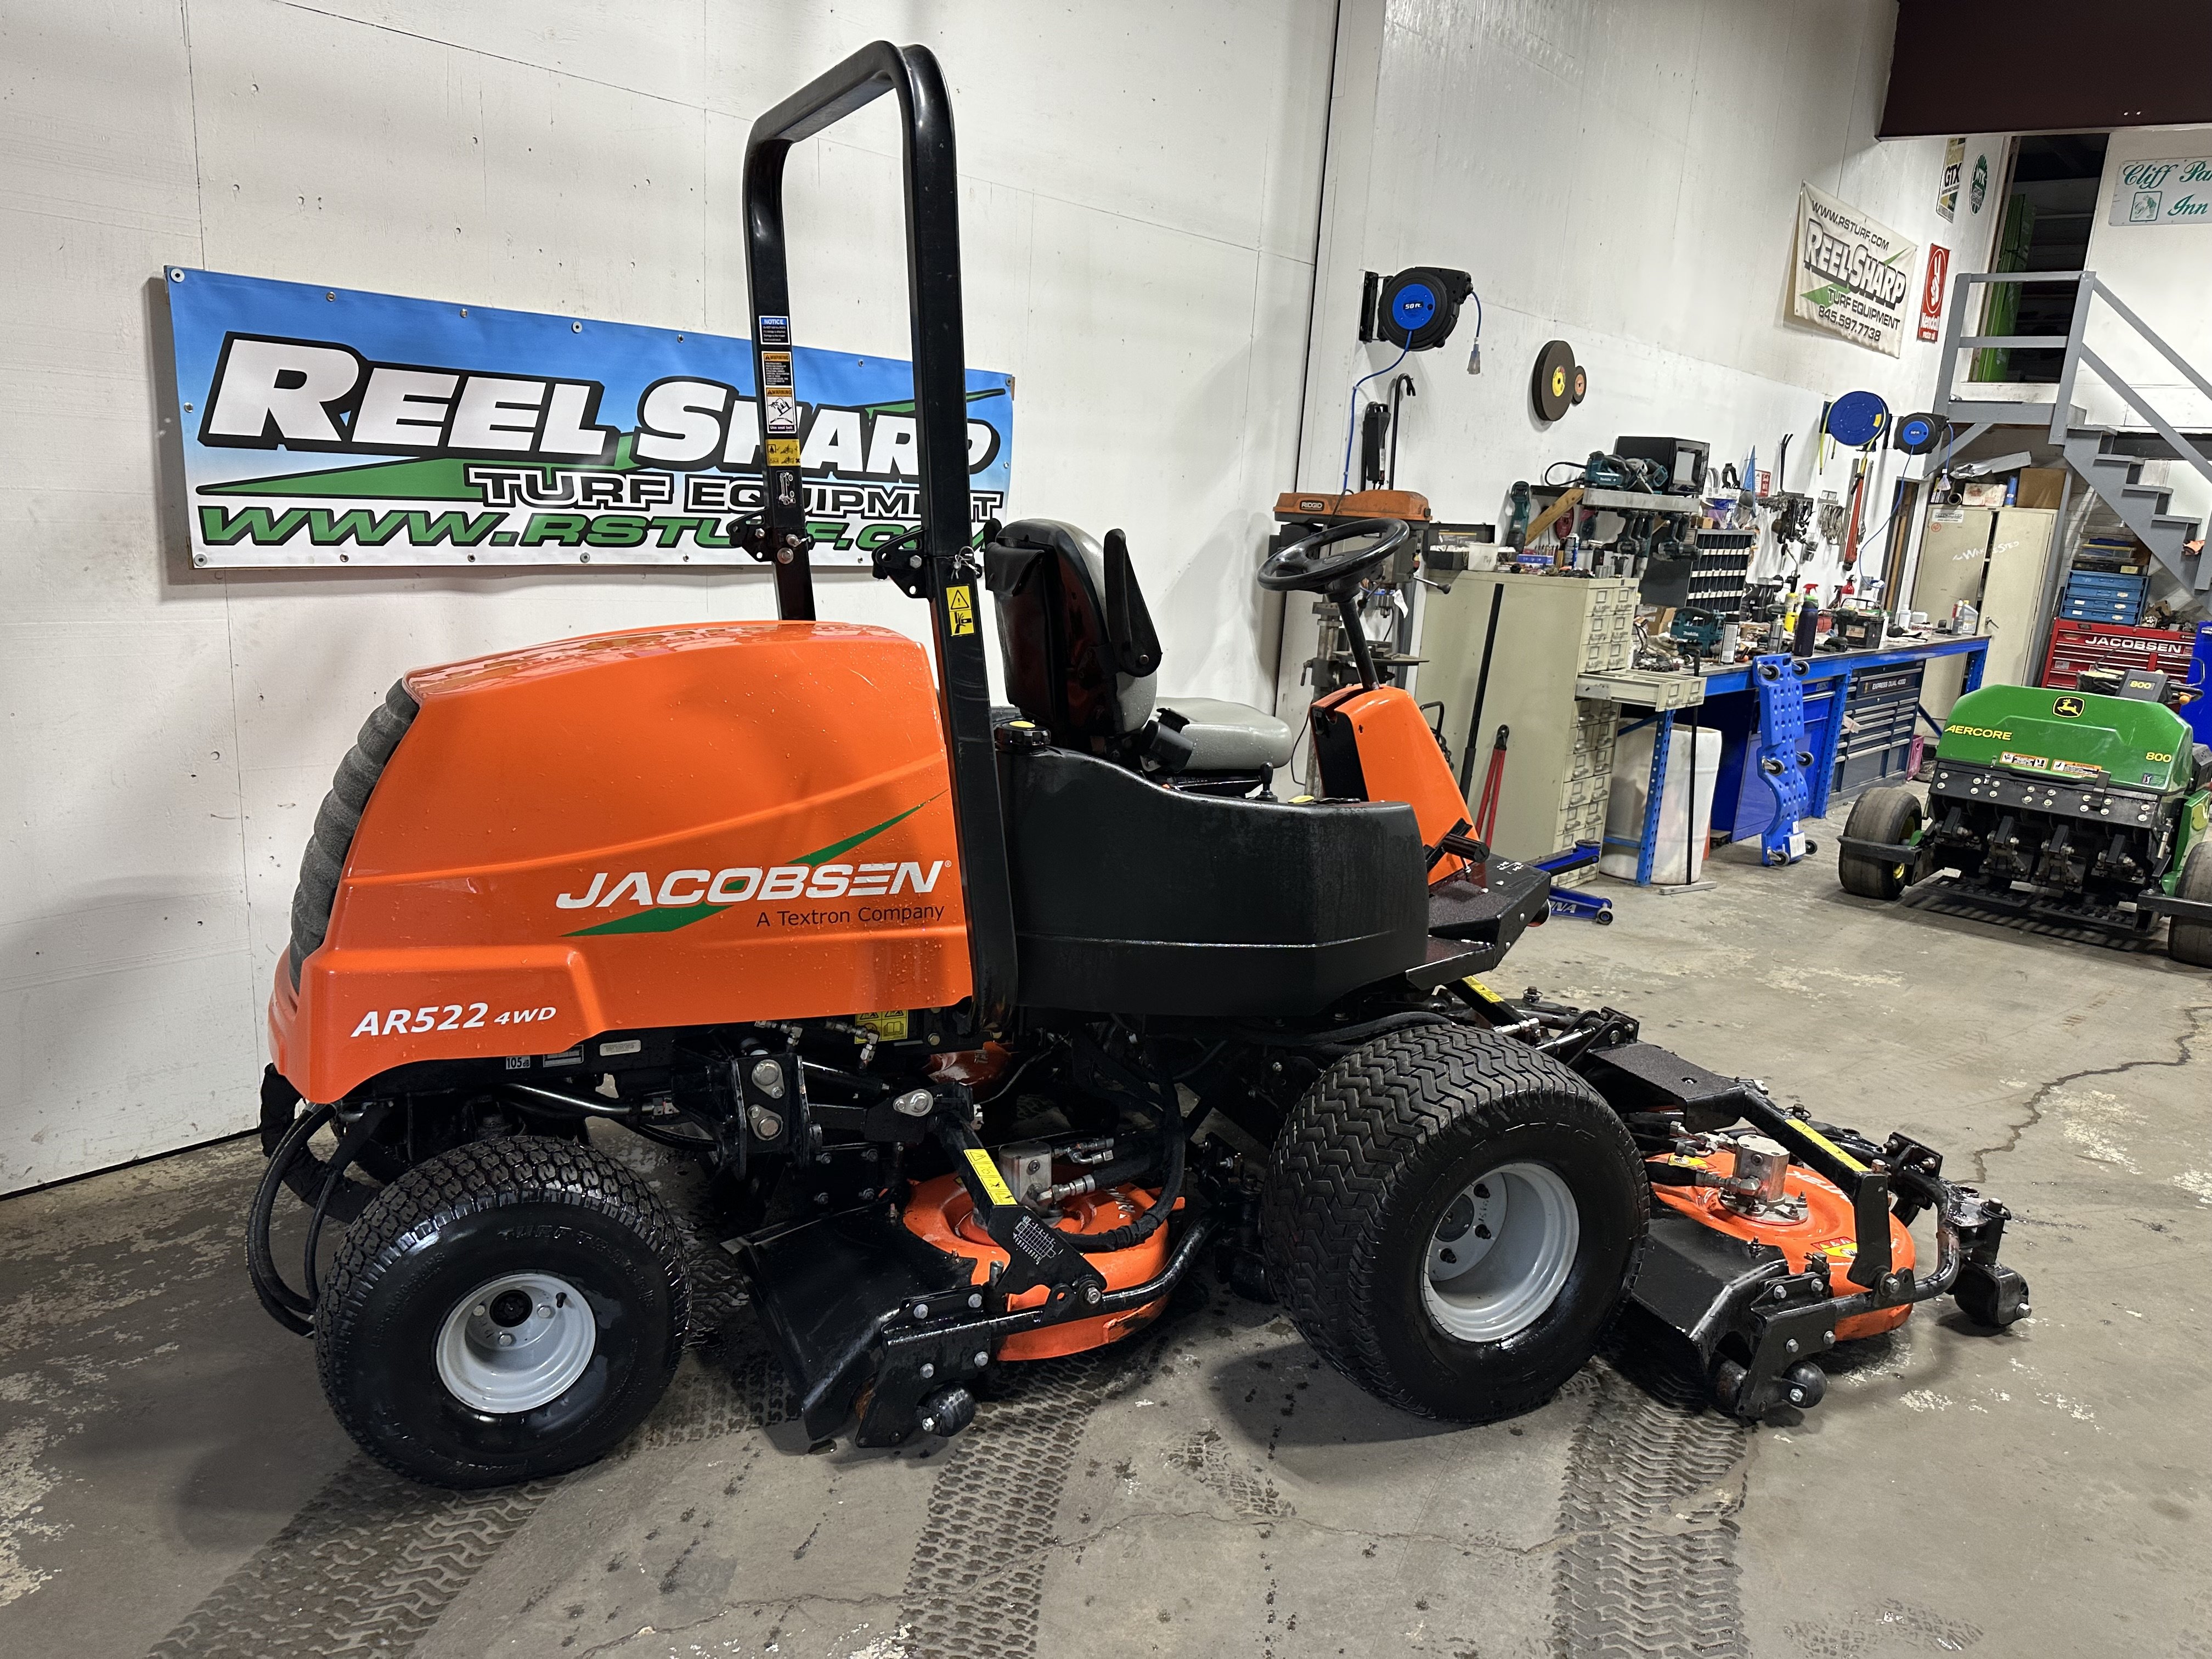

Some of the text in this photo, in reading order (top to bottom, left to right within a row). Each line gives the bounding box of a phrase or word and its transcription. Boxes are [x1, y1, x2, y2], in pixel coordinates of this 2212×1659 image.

[1944, 162, 1962, 187] GTX
[2123, 160, 2212, 189] Cliff Pa
[2168, 194, 2208, 216] Inn
[1812, 200, 1889, 250] WWW.RSTURF.COM
[1804, 218, 1906, 308] REEL SHARP
[1828, 286, 1900, 330] TURF EQUIPMENT
[1818, 305, 1881, 342] 845.597.7738
[203, 335, 610, 459] REEL
[475, 469, 671, 508] TURF
[2085, 636, 2182, 653] JACOBSEN
[2130, 680, 2152, 690] 800
[1944, 724, 2013, 741] AERCORE
[2146, 752, 2172, 763] 800
[556, 860, 945, 909] JACOBSEN
[757, 905, 945, 927] A Textron Company
[350, 1002, 556, 1037] AR522 4WD
[507, 1057, 530, 1069] 105 dB
